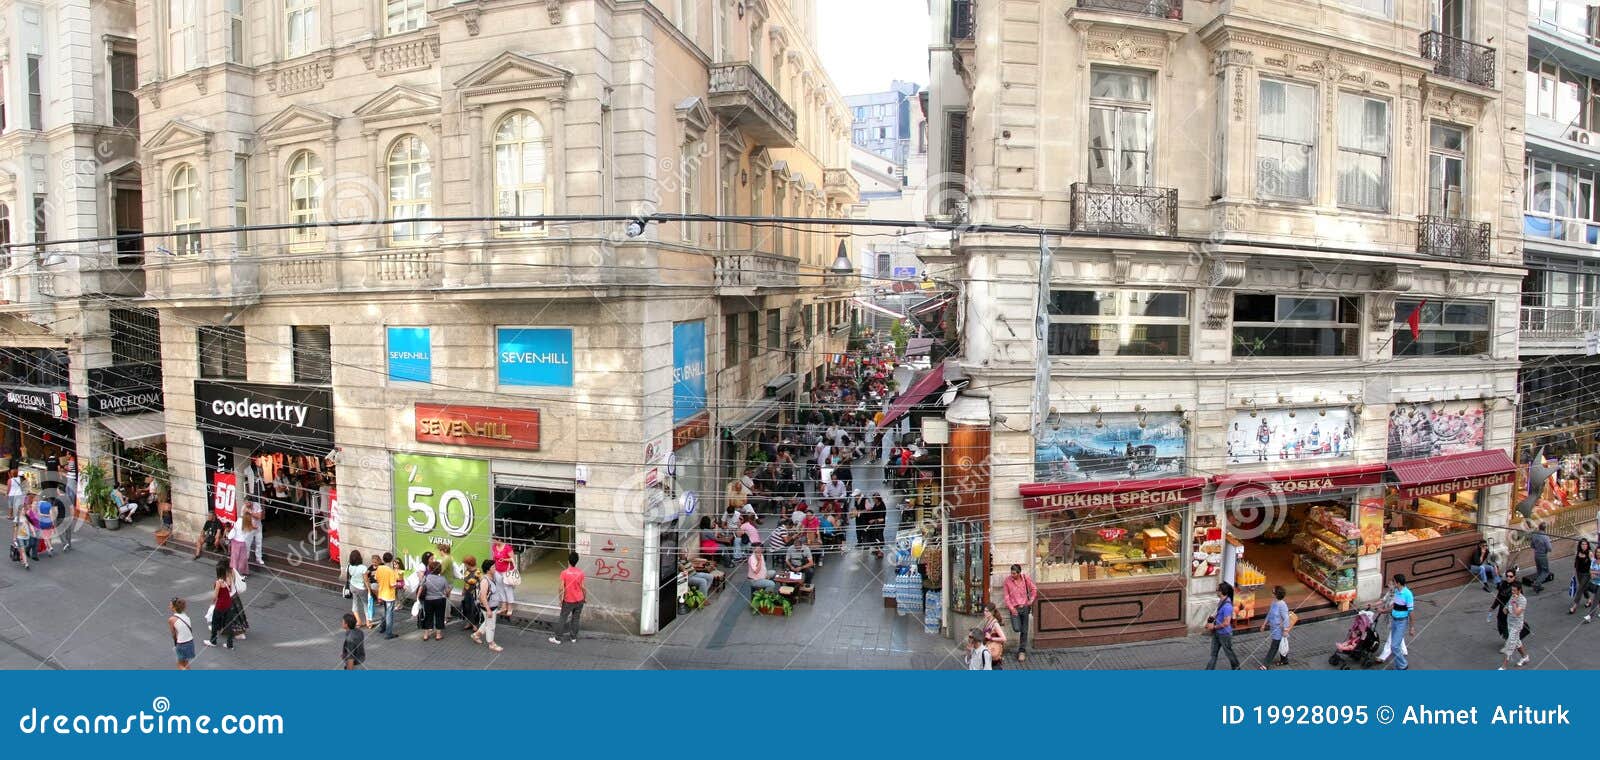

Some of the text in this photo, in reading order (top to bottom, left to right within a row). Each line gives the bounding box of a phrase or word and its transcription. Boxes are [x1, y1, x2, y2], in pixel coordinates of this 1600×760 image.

[390, 352, 429, 360] SEVENHILL
[501, 351, 568, 365] SEVENHILL
[8, 392, 46, 406] BARCELONA
[101, 393, 160, 410] BARCELONA
[212, 398, 307, 427] codentry
[419, 417, 512, 439] SEVENHILL
[1270, 478, 1334, 493] KOSKA
[1408, 473, 1510, 497] TURKISH DELIGHT
[215, 481, 236, 512] 50
[1040, 491, 1188, 507] TURKISH SPECIAL
[429, 536, 453, 546] VARAN
